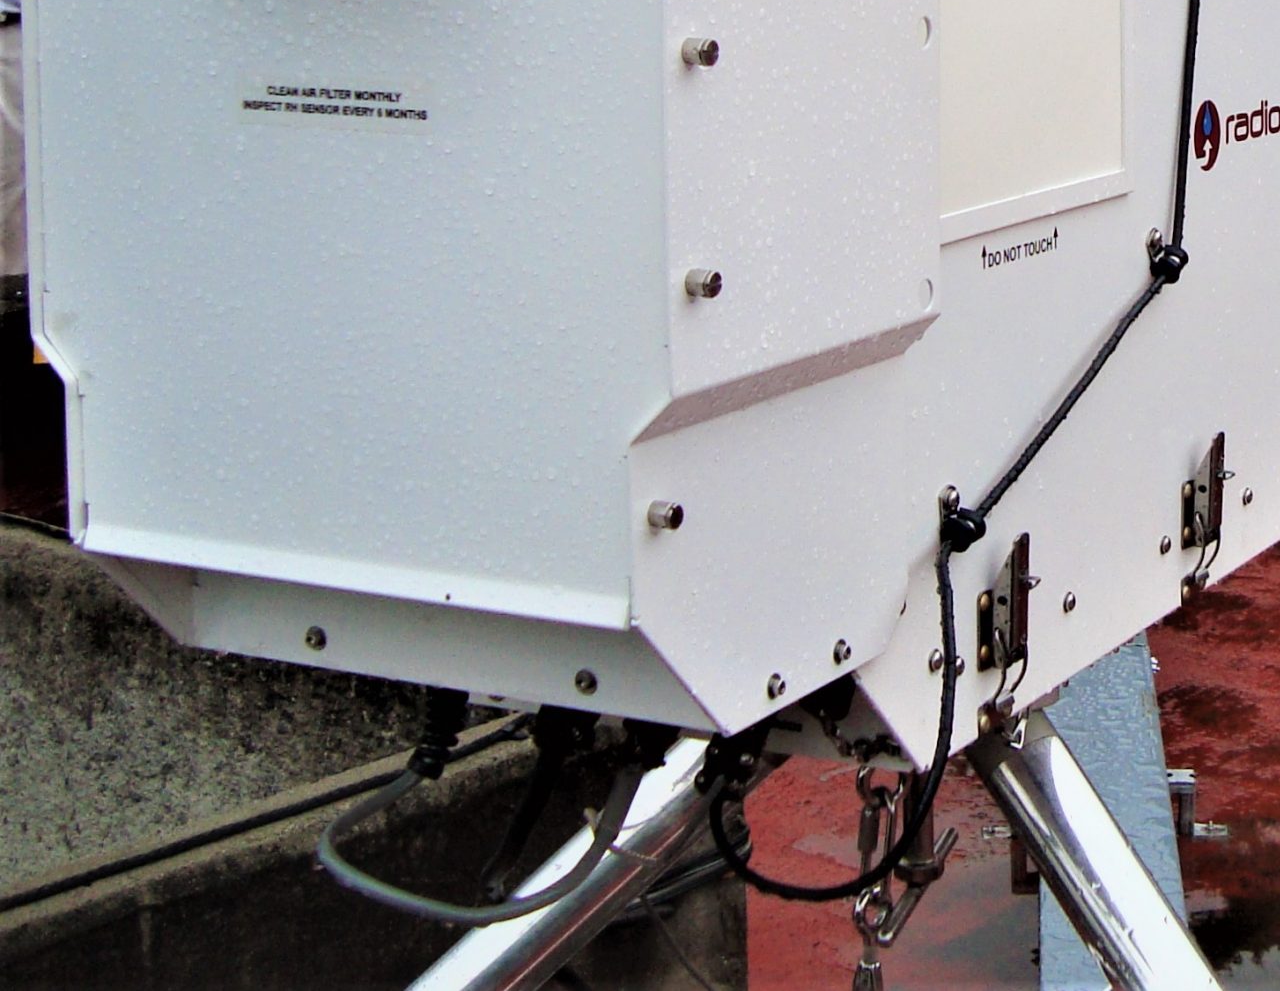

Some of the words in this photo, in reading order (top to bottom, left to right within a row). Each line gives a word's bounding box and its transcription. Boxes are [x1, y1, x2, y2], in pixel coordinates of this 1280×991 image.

[266, 85, 299, 96] CLEAN
[301, 87, 316, 97] AIR
[319, 88, 351, 100] FILTER
[354, 91, 402, 103] MONTHLY
[243, 100, 282, 111] INSPECT
[301, 103, 340, 116] SENSOR
[342, 106, 374, 117] EVERY
[385, 108, 428, 121] MONTHS
[988, 251, 1001, 268] DO
[1003, 245, 1021, 263] NOT
[1024, 237, 1052, 258] TOUCH
